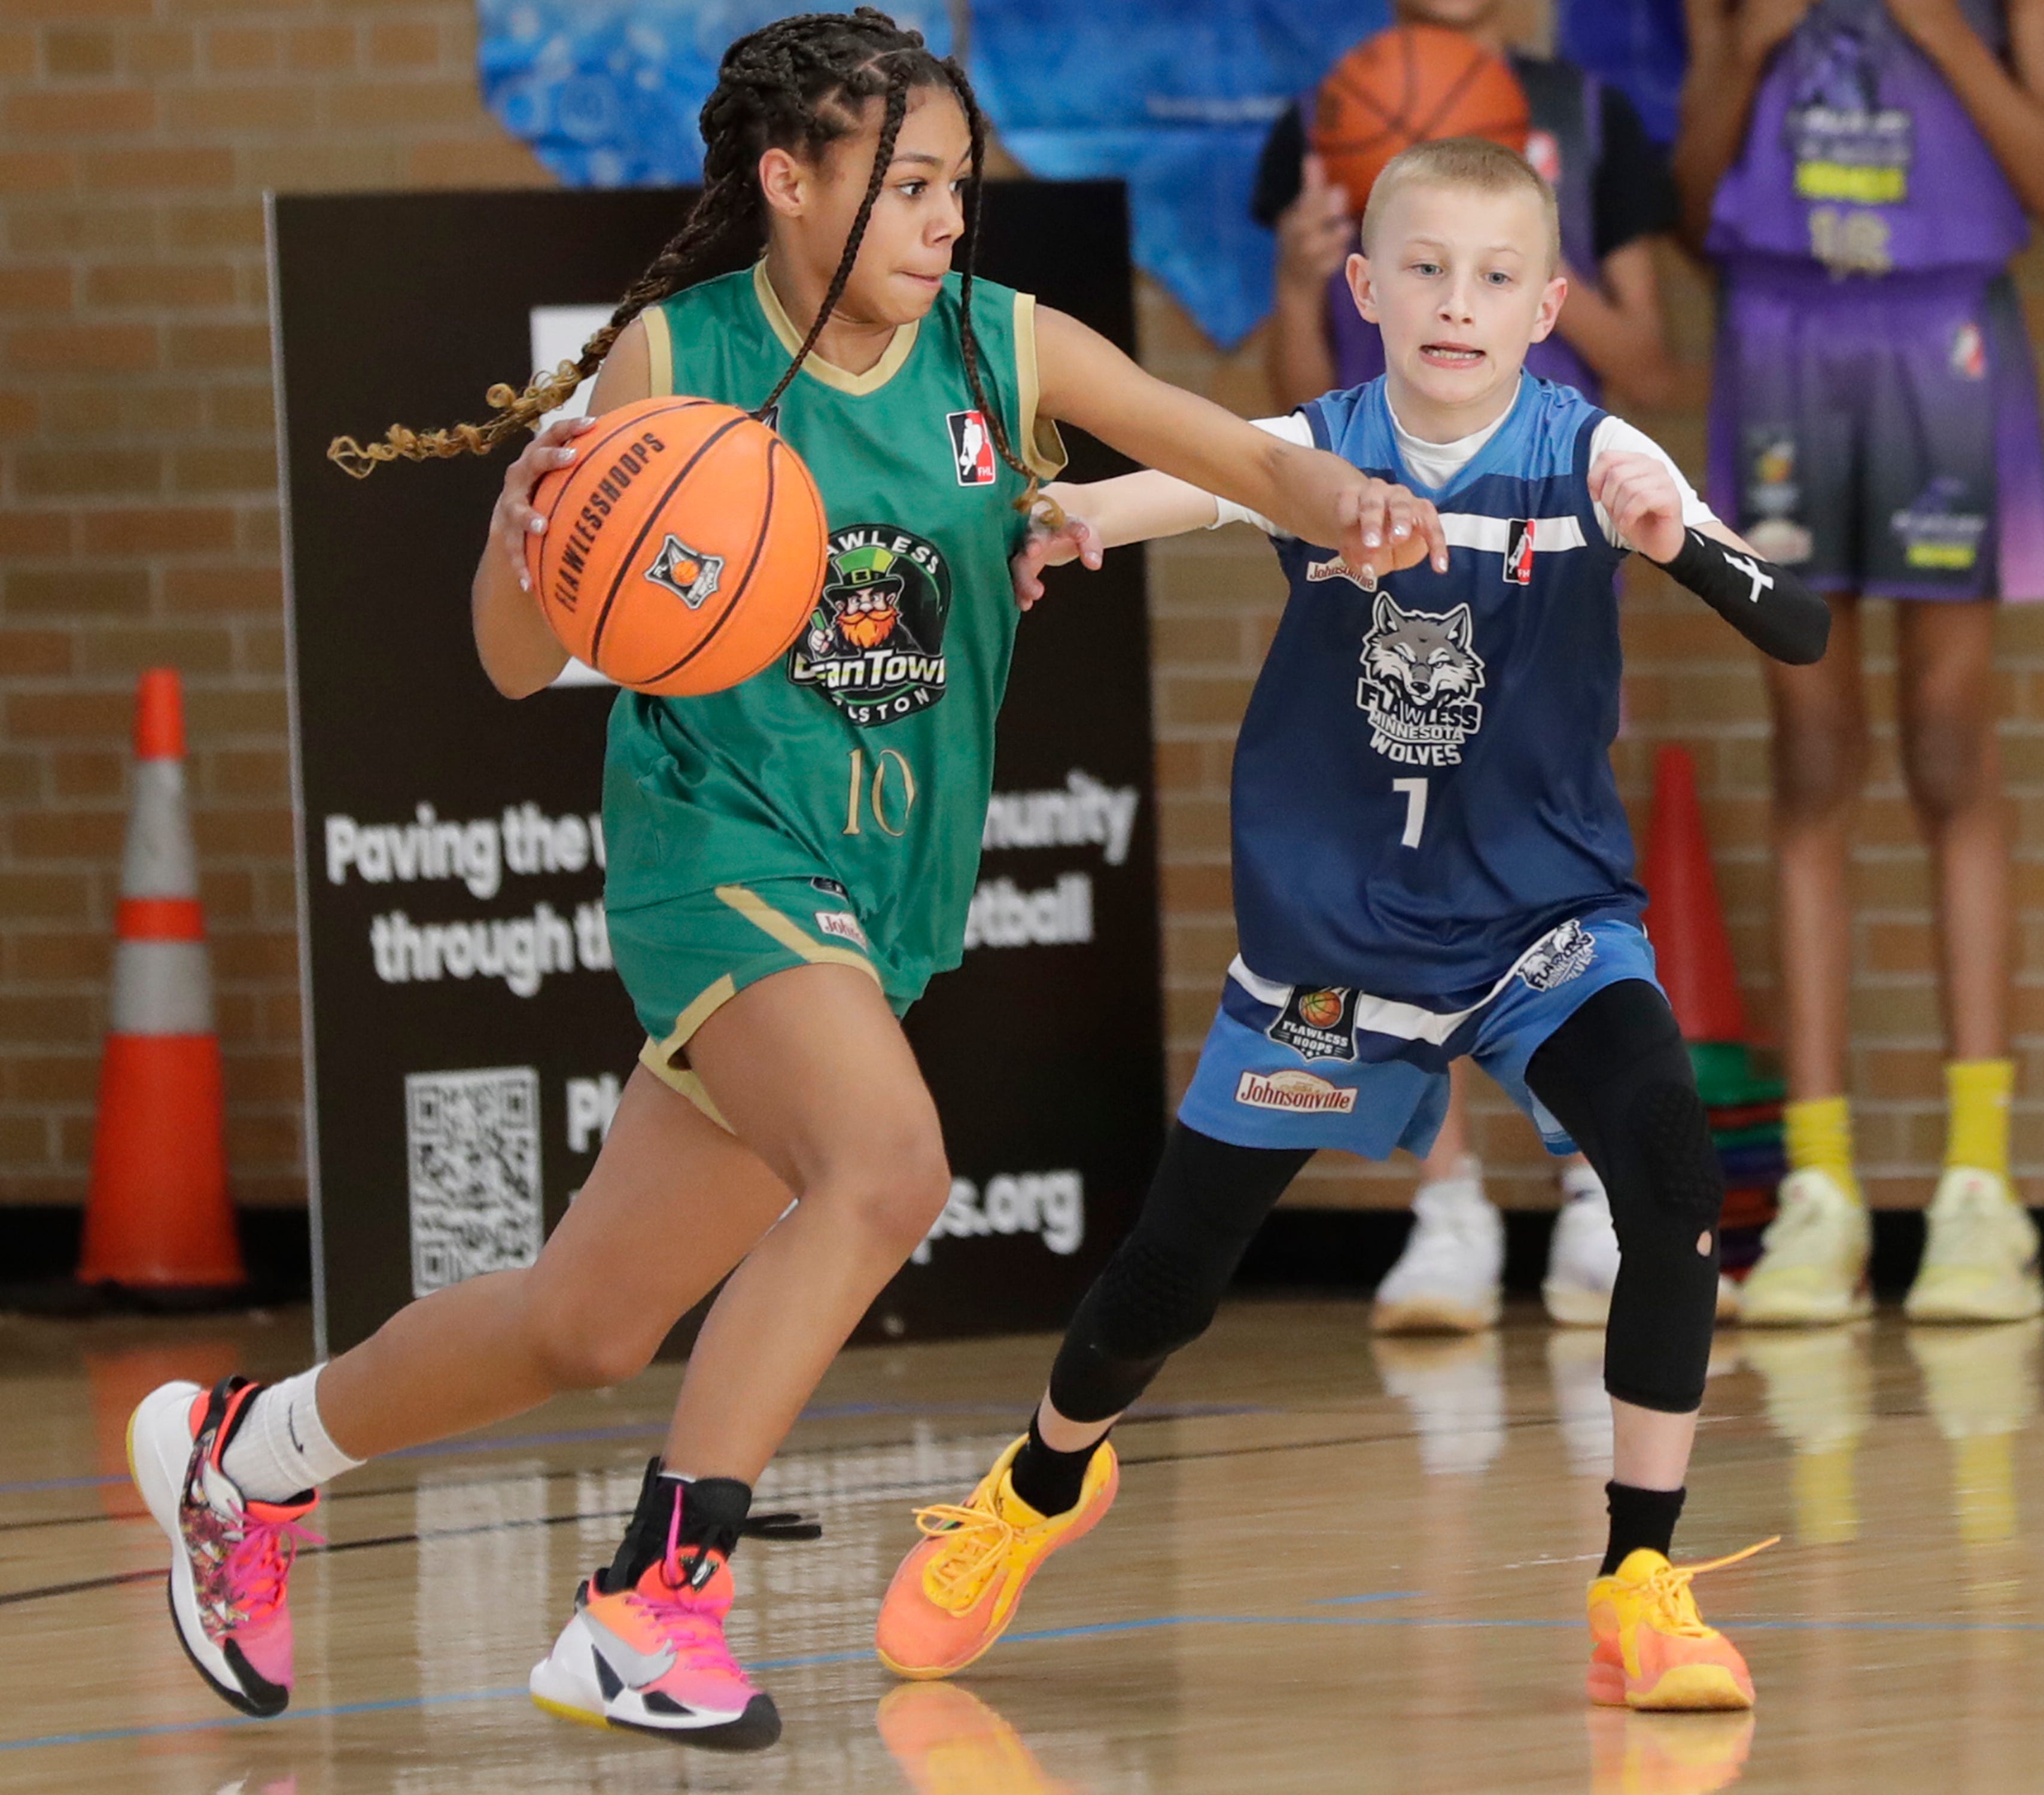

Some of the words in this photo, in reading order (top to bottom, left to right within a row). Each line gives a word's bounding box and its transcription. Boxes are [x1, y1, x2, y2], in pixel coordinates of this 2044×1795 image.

[977, 466, 993, 477] FHL
[554, 432, 665, 614] FLAWLESSHOOPS
[826, 530, 939, 574] AWLESS
[1517, 568, 1531, 578] FH
[1359, 681, 1480, 732] FLAWLESS
[1368, 710, 1464, 740] MINNESOTA
[1369, 728, 1462, 766] WOLVES
[841, 748, 916, 837] 10
[326, 804, 501, 899] Paving
[501, 804, 589, 874] the
[370, 902, 573, 997] through
[1282, 1020, 1349, 1047] FLAWLESS
[1292, 1035, 1334, 1054] HOOPS
[1241, 1077, 1350, 1109] Johnsonville
